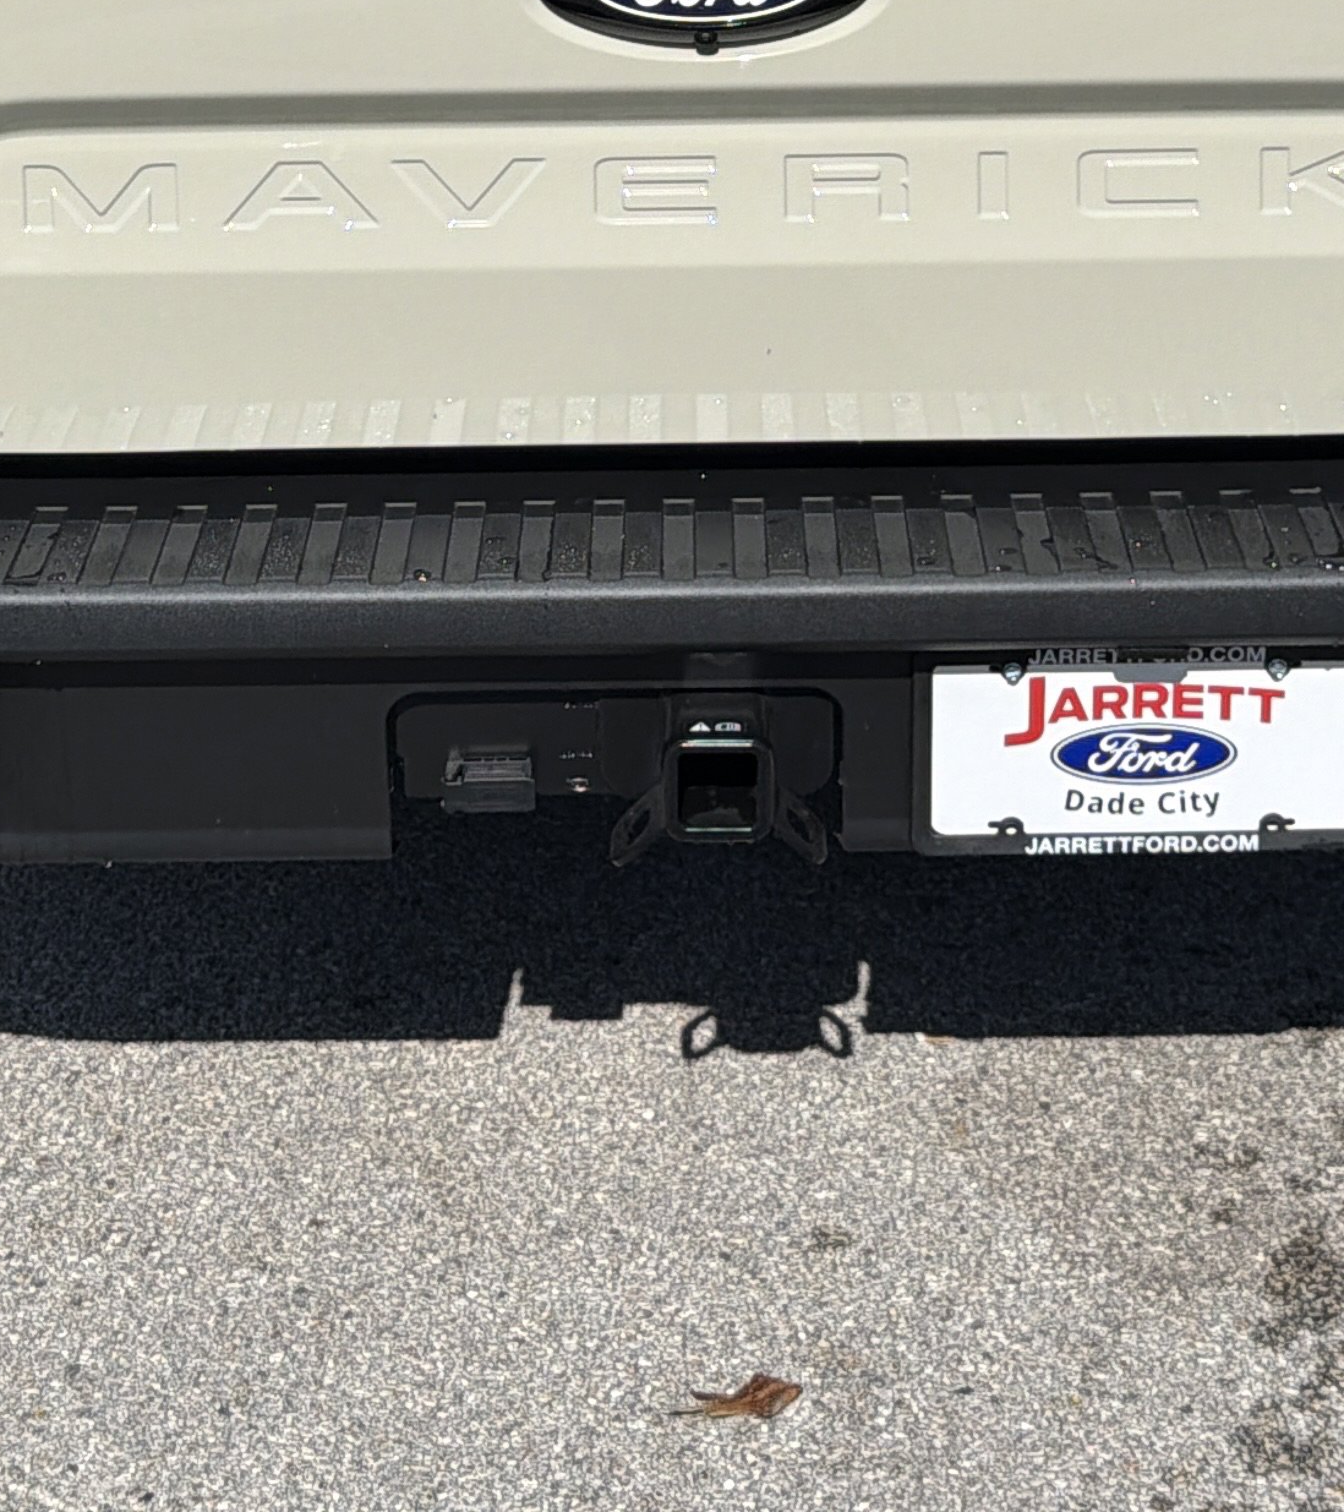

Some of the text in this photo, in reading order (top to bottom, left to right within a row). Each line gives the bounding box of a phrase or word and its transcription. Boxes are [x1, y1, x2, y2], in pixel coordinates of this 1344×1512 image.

[1003, 675, 1286, 747] JARRETT
[1087, 731, 1201, 775] Ford
[1064, 788, 1221, 818] Dade City
[1024, 833, 1260, 856] JARRETTFORD.COM
